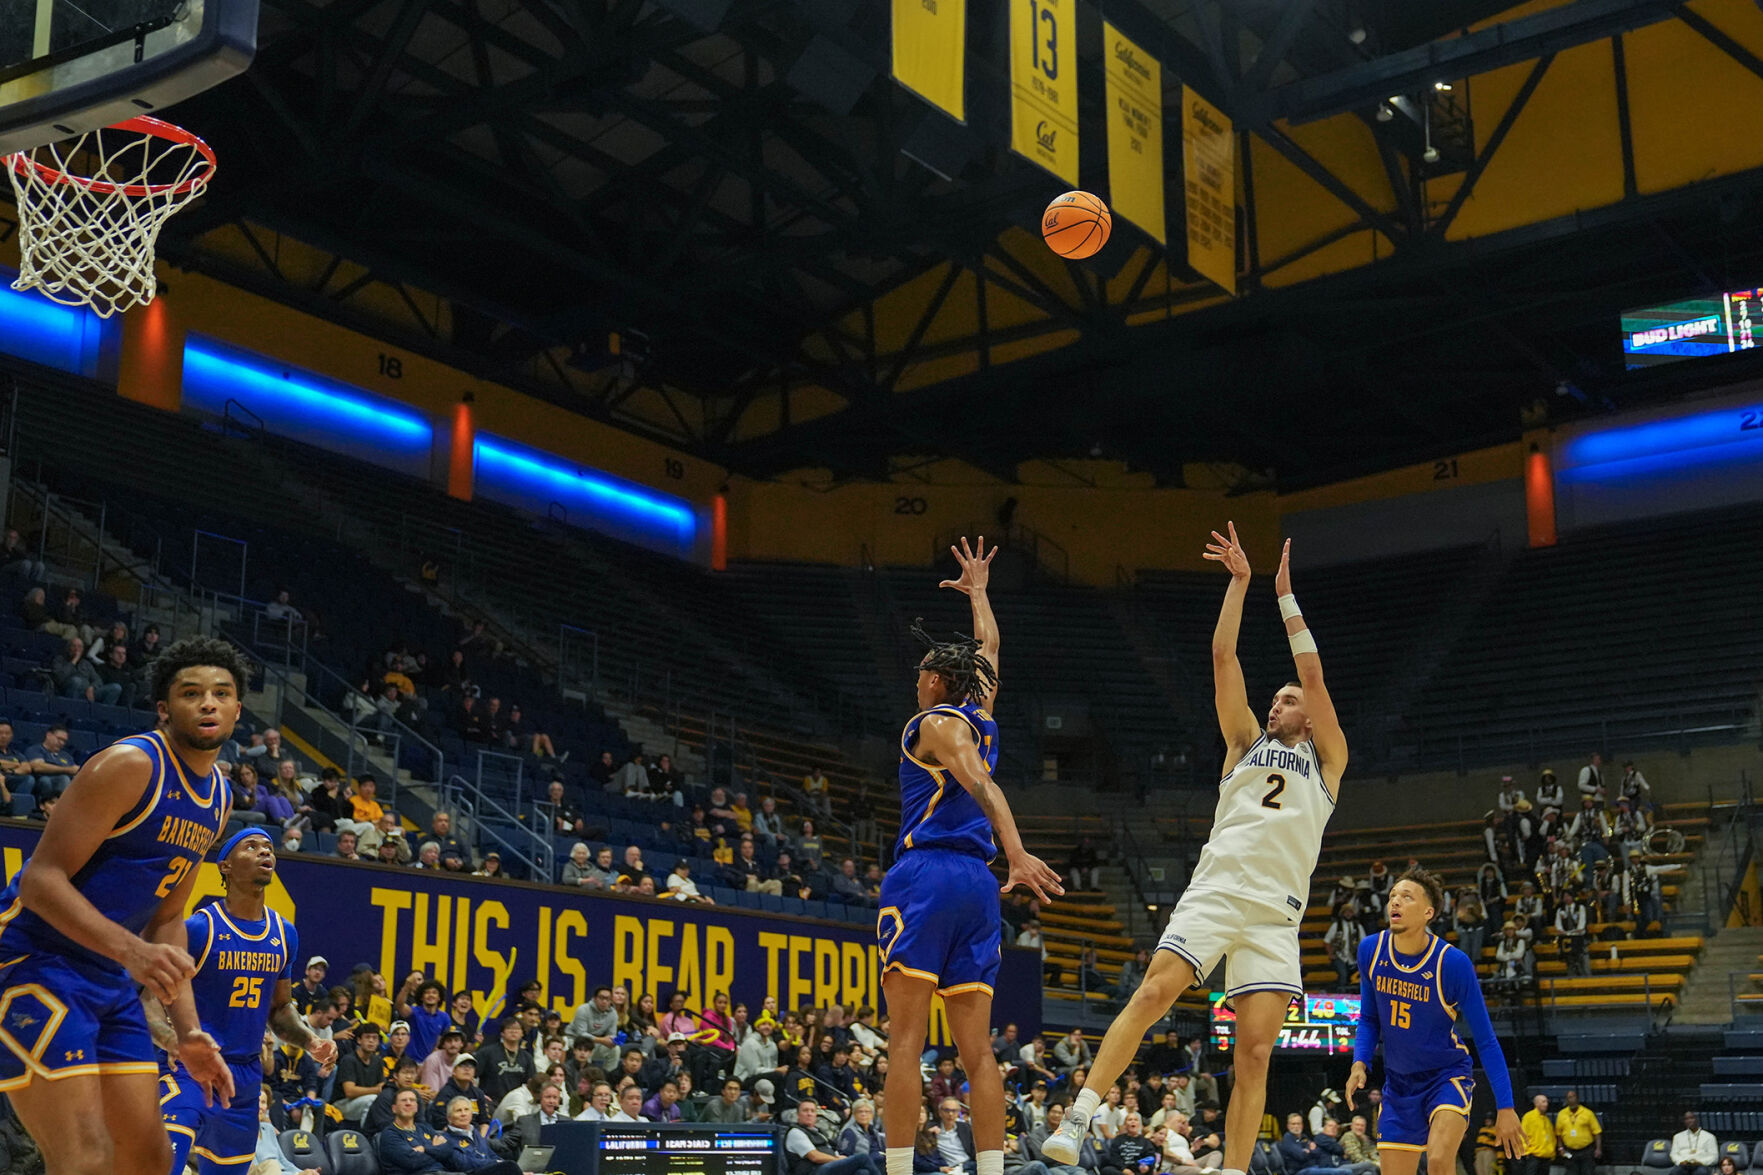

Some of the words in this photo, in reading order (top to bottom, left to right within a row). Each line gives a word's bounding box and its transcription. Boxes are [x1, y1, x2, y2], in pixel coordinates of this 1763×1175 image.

[1030, 0, 1058, 80] 13
[1036, 121, 1056, 152] Cal
[1632, 328, 1668, 347] BUD
[1669, 318, 1718, 340] LIGHT
[379, 353, 403, 379] 18
[1739, 410, 1763, 431] 2
[664, 457, 684, 480] 19
[1433, 460, 1458, 480] 21
[895, 497, 927, 515] 20
[1245, 748, 1311, 780] ALIFORNIA
[1261, 773, 1287, 810] 2
[218, 950, 281, 973] BAKERSFIELD
[371, 887, 510, 1019] THIS
[536, 906, 588, 1023] IS
[613, 914, 735, 1024] BEAR
[229, 976, 265, 1008] 25
[1376, 975, 1430, 1003] BAKERSFIELD
[1390, 999, 1412, 1029] 15
